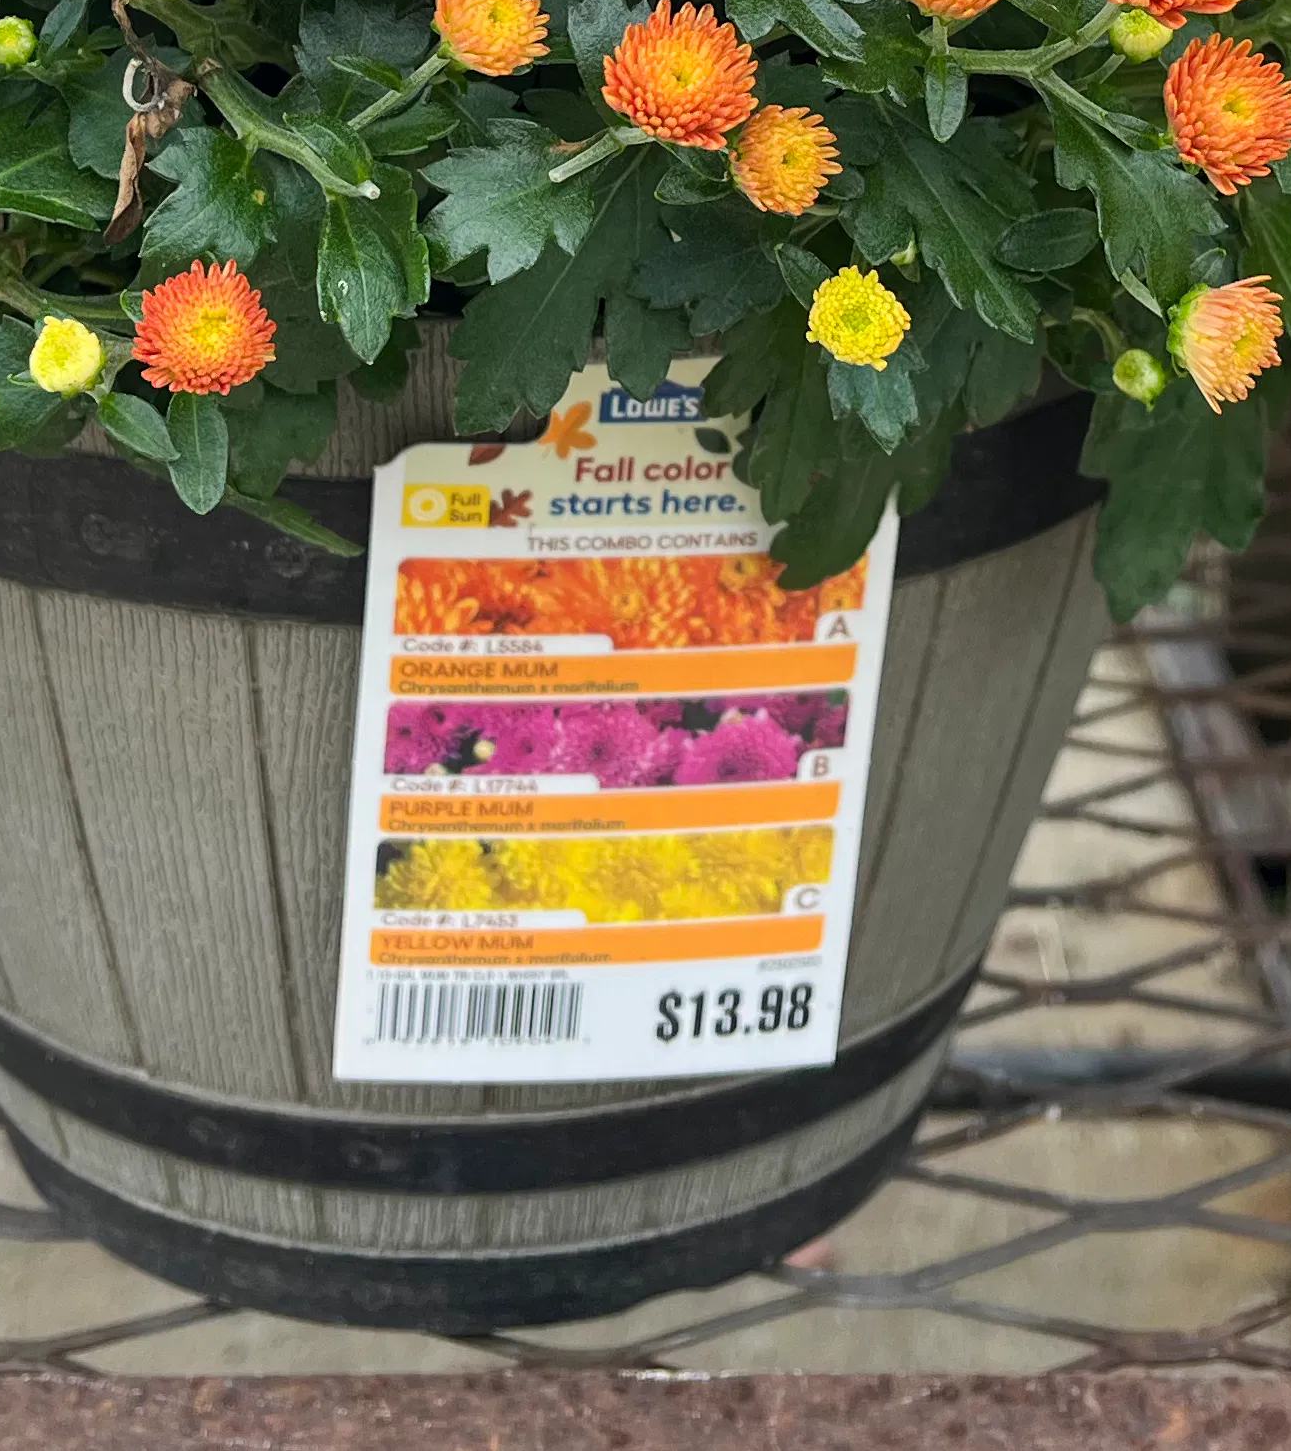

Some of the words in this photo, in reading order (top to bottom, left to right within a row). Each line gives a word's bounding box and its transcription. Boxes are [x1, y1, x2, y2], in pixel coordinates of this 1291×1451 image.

[612, 395, 699, 419] LOWE'S
[575, 456, 634, 483] Fall
[644, 455, 729, 482] color
[451, 492, 481, 507] Full
[550, 489, 651, 516] starts
[662, 488, 746, 514] here.
[449, 509, 483, 523] Sun
[528, 534, 568, 551] THIS
[574, 533, 652, 551] COMBO
[656, 531, 759, 549] CONTAINS
[827, 615, 851, 639] A
[403, 638, 454, 653] Code
[400, 661, 495, 678] ORANGE
[502, 661, 558, 677] MUM
[399, 680, 535, 695] Chrysanthemum
[813, 755, 829, 777] B
[391, 778, 442, 792] Code
[389, 801, 472, 817] PURPLE
[478, 801, 534, 816] MUM
[796, 887, 821, 909] C
[381, 913, 431, 927] Code
[381, 935, 476, 950] YELLOW
[480, 934, 534, 949] MUM
[656, 983, 813, 1043] $13.98
